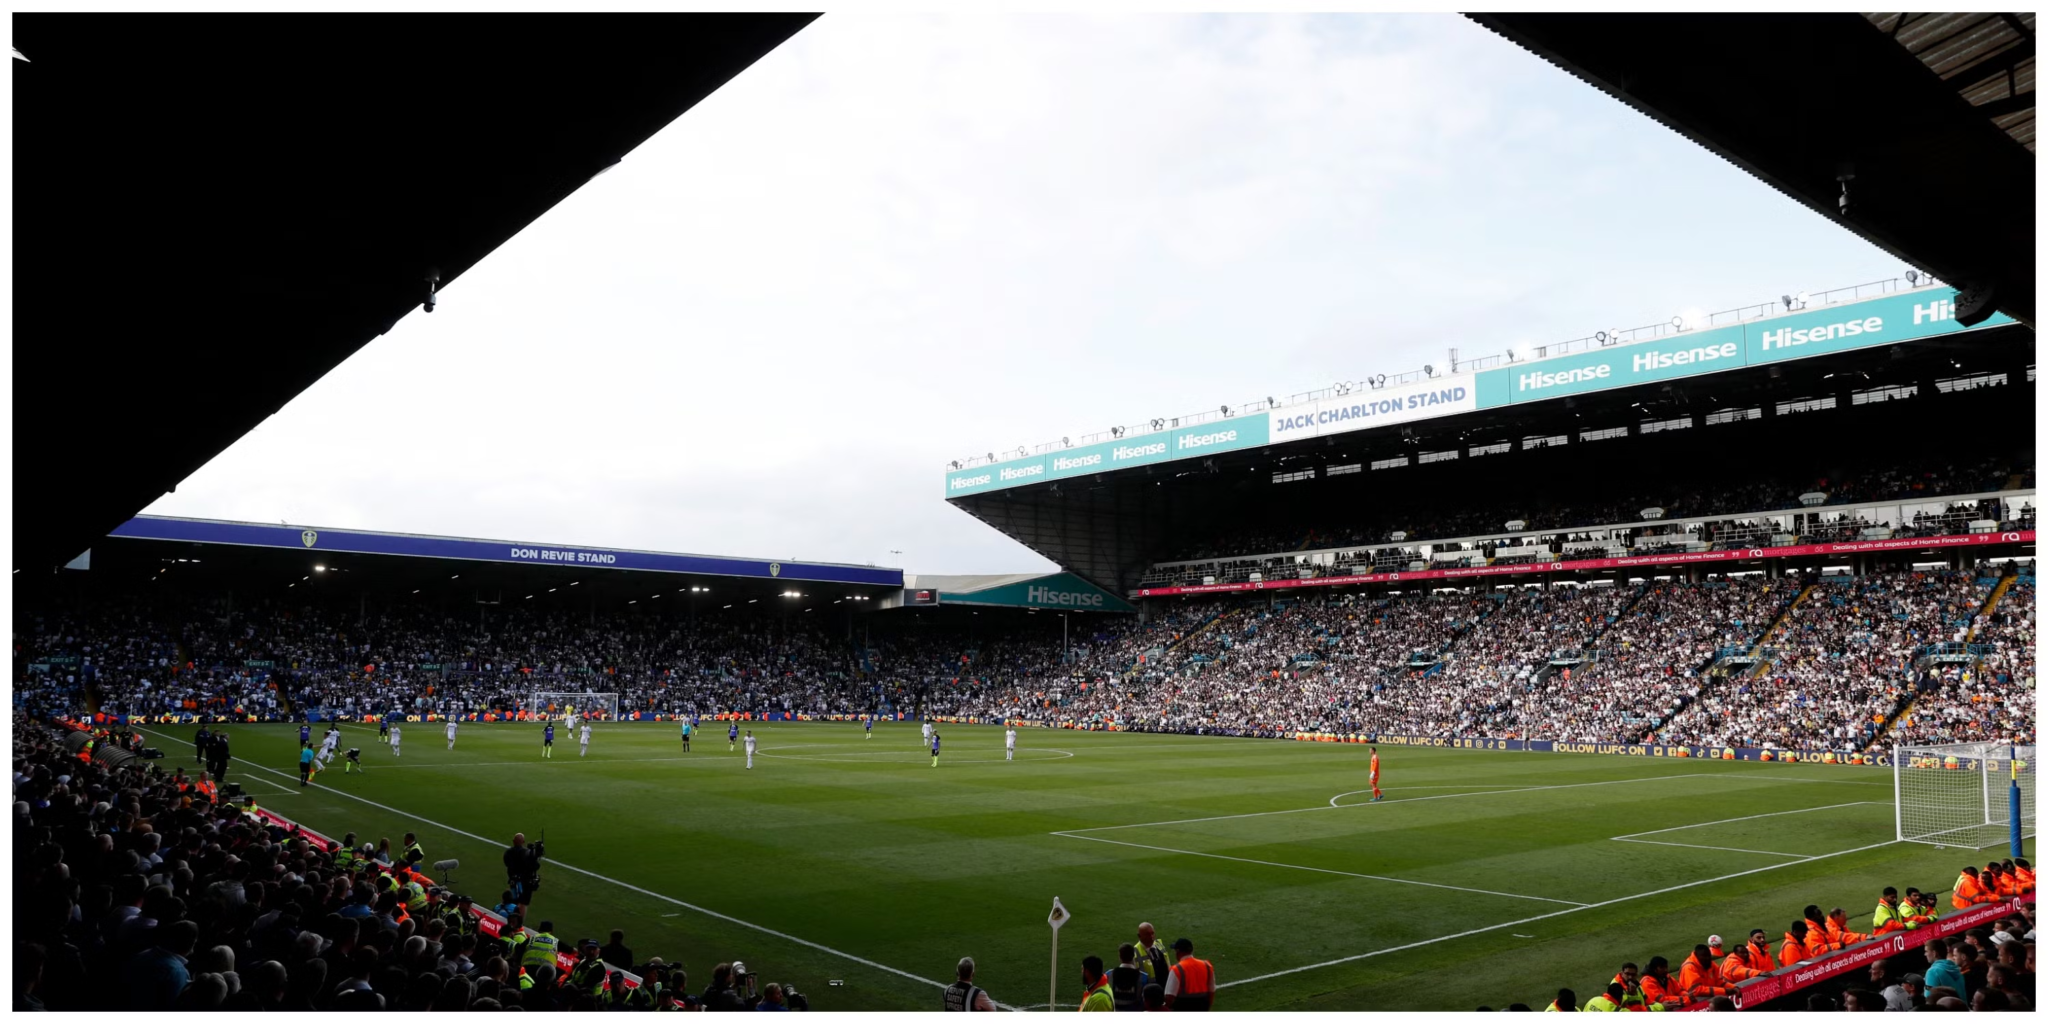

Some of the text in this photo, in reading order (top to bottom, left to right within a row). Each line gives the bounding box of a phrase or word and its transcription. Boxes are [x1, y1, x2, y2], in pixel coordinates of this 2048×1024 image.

[1762, 316, 1883, 351] Hisense
[1632, 342, 1737, 372] Hisense
[1519, 363, 1611, 391] Hisense
[1276, 387, 1466, 432] JACK CHARLTON STAND
[1178, 429, 1237, 450] Hisense
[1113, 441, 1166, 461] Hisense
[1053, 452, 1101, 471] Hisense
[951, 472, 991, 490] Hisense
[1000, 463, 1043, 481] Hisense
[511, 548, 616, 564] DON REVIE STAND
[1028, 585, 1103, 607] Hisense
[1376, 734, 1407, 745] OLLOW
[1409, 736, 1432, 746] LUFC
[1598, 744, 1626, 755] LUFC
[1628, 745, 1646, 756] ON
[1837, 753, 1873, 765] LUC
[1940, 921, 1955, 933] Dealing
[1967, 913, 1980, 924] aspects
[1980, 911, 1984, 919] of
[1984, 908, 1994, 917] Home
[1993, 905, 2006, 914] Finance
[1741, 980, 1781, 1004] mortgages
[1795, 969, 1814, 984] Dealing
[1814, 964, 1825, 976] with
[1831, 957, 1848, 971] aspects
[1848, 954, 1854, 964] of
[1854, 950, 1867, 963] Home
[1867, 946, 1883, 958] Finance
[946, 993, 963, 1004] SAFETY
